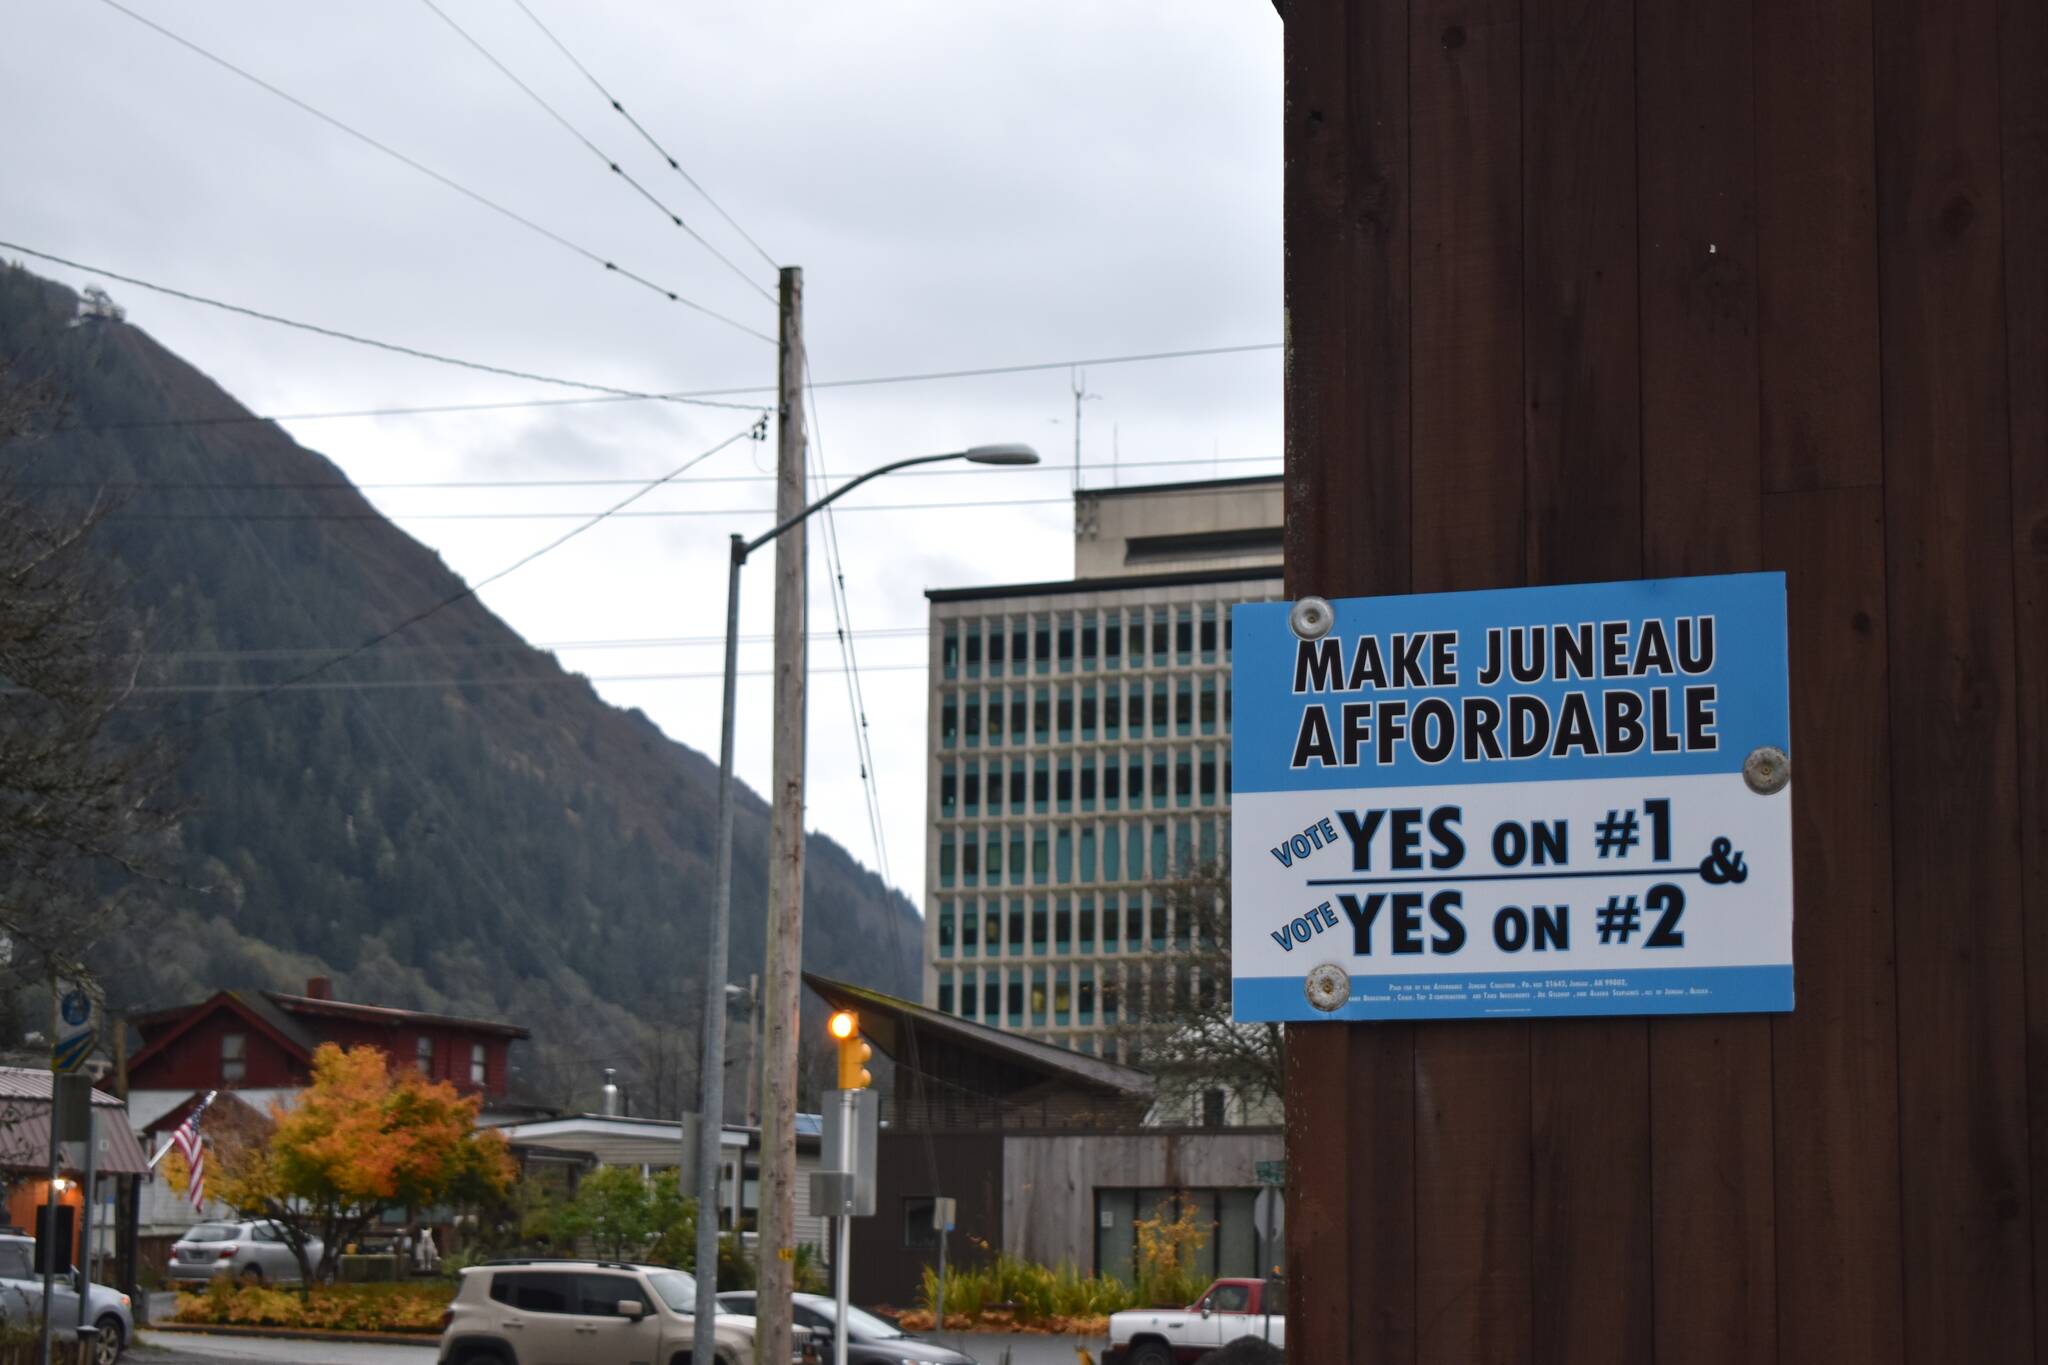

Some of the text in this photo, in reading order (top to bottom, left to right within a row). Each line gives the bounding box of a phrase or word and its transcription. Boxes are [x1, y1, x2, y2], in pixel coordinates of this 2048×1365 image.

[1293, 615, 1715, 695] MAKE JUNEAU
[1289, 685, 1718, 770] AFFORDABLE
[1270, 798, 1748, 885] VOTE YES ON #1 &
[1270, 883, 1686, 957] VOTE YES ON #2
